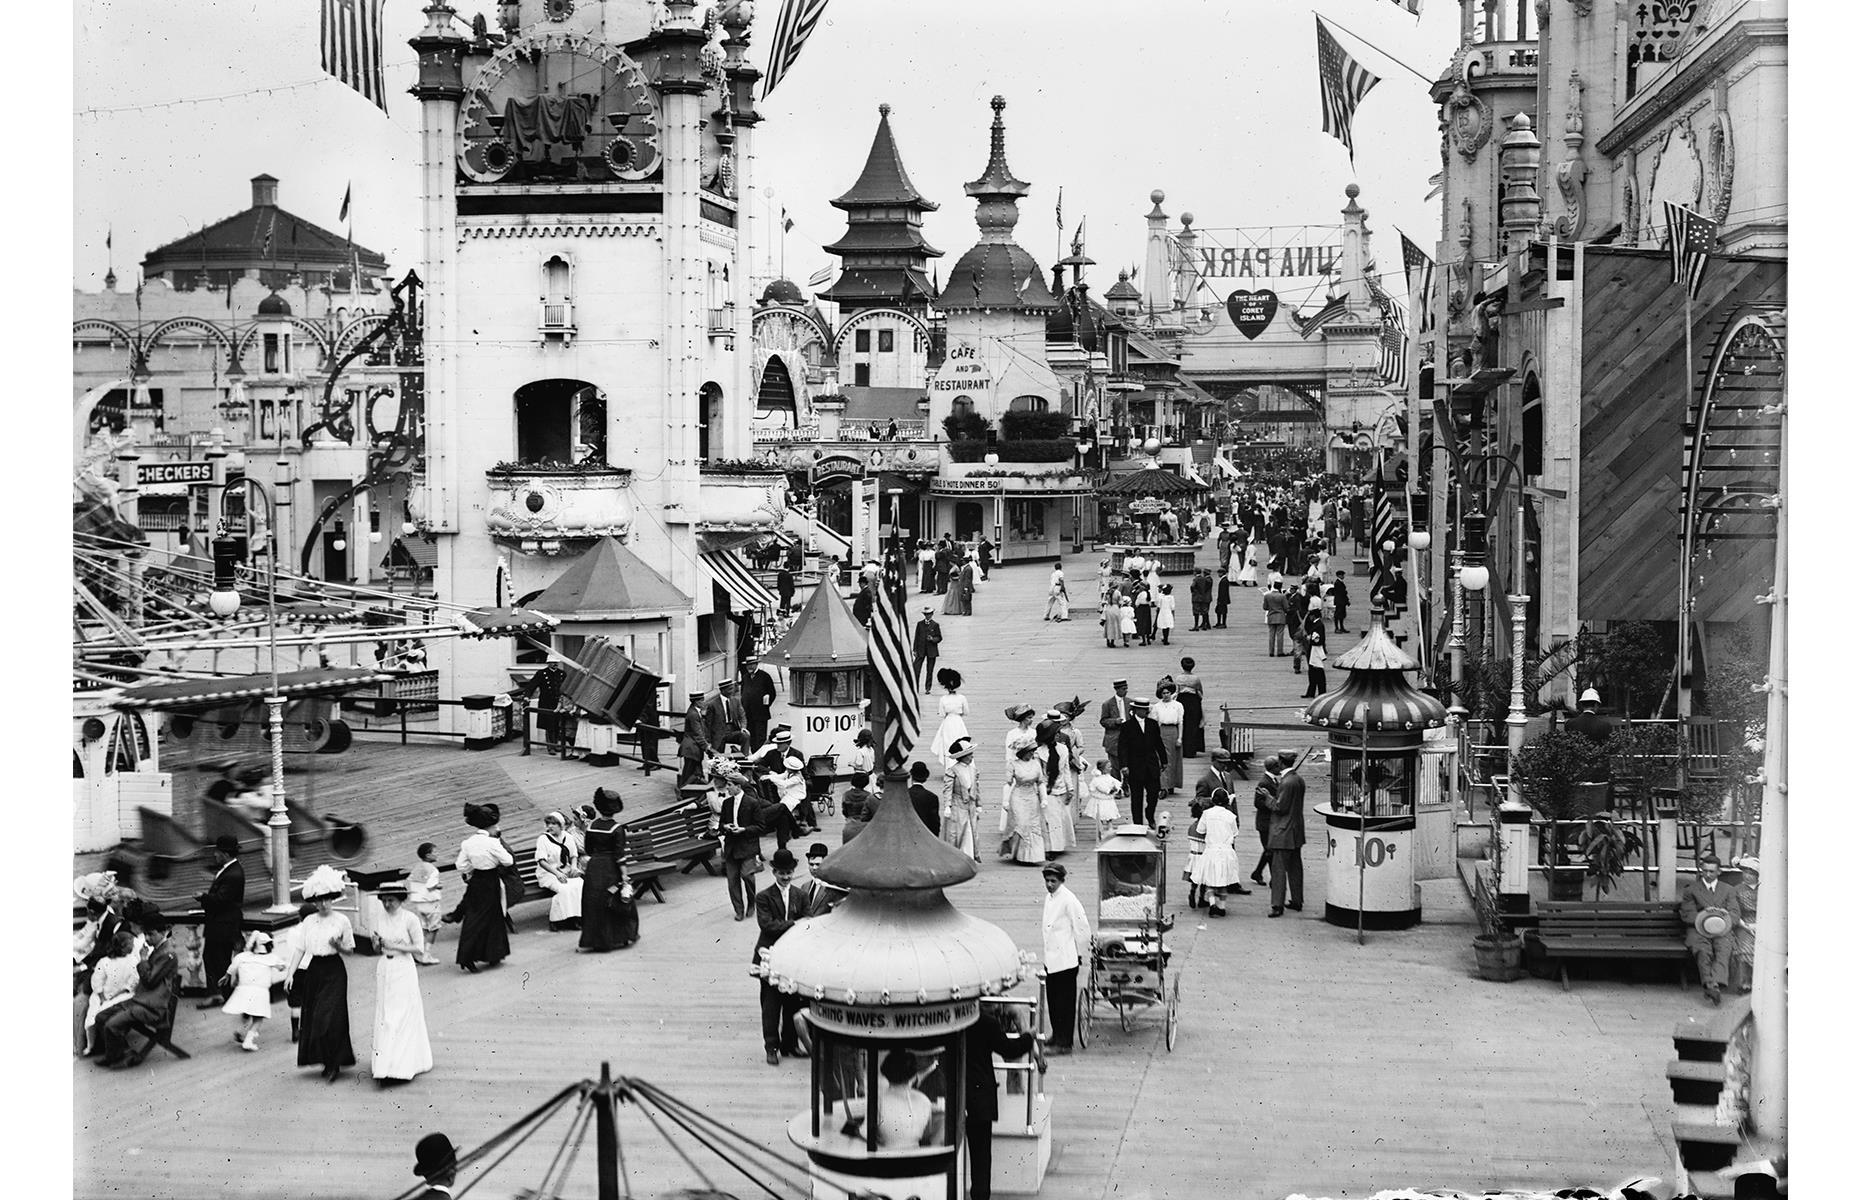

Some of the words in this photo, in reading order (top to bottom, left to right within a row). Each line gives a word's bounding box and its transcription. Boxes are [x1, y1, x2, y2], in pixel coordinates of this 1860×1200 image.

[955, 365, 969, 373] AND
[934, 379, 991, 391] RESTAURANT
[137, 465, 211, 482] CHECKERS
[816, 460, 861, 477] RESTAURANT
[959, 480, 985, 489] DINNER
[894, 1008, 951, 1028] WITCHING
